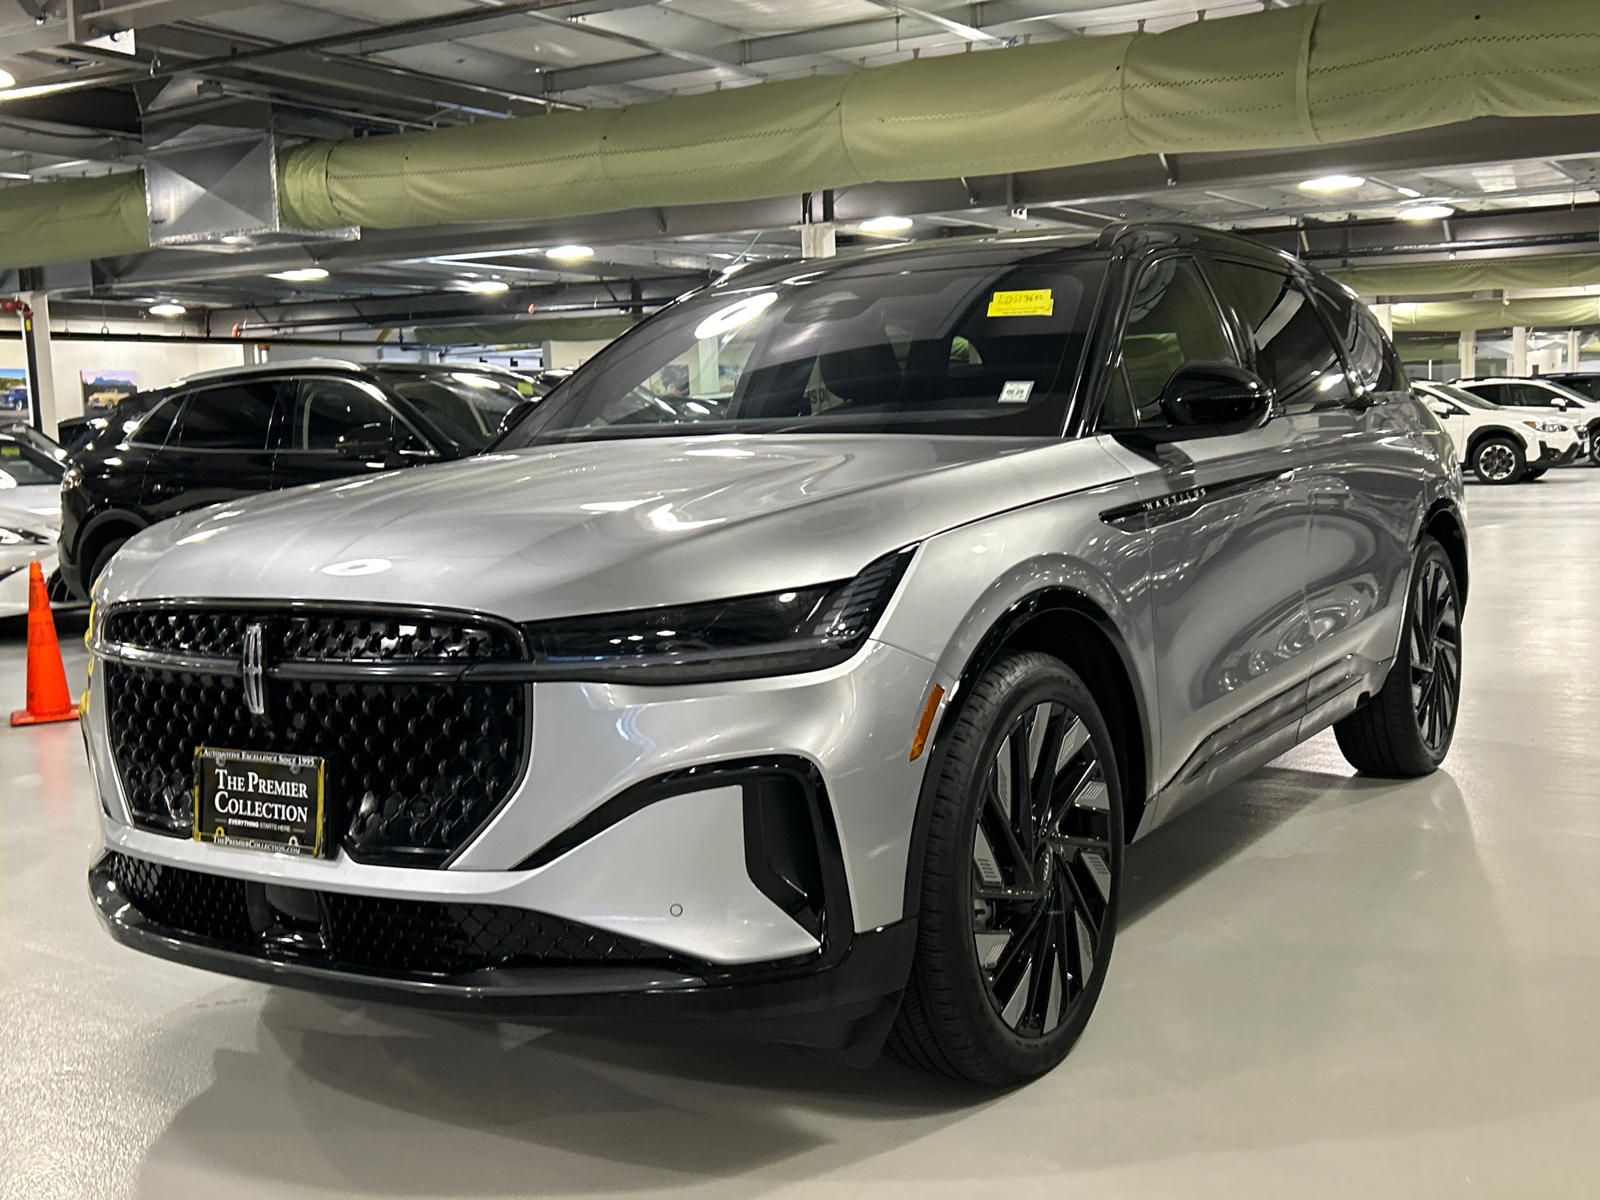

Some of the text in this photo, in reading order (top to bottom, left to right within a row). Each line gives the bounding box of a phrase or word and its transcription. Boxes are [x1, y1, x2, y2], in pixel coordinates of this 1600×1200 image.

[1145, 488, 1206, 511] NAUTILUS
[242, 751, 277, 763] EXCELLENCE
[298, 756, 315, 766] 1995
[215, 768, 308, 798] THE PREMIER
[214, 791, 308, 823] COLLECTION
[228, 818, 259, 828] EVERYTHING
